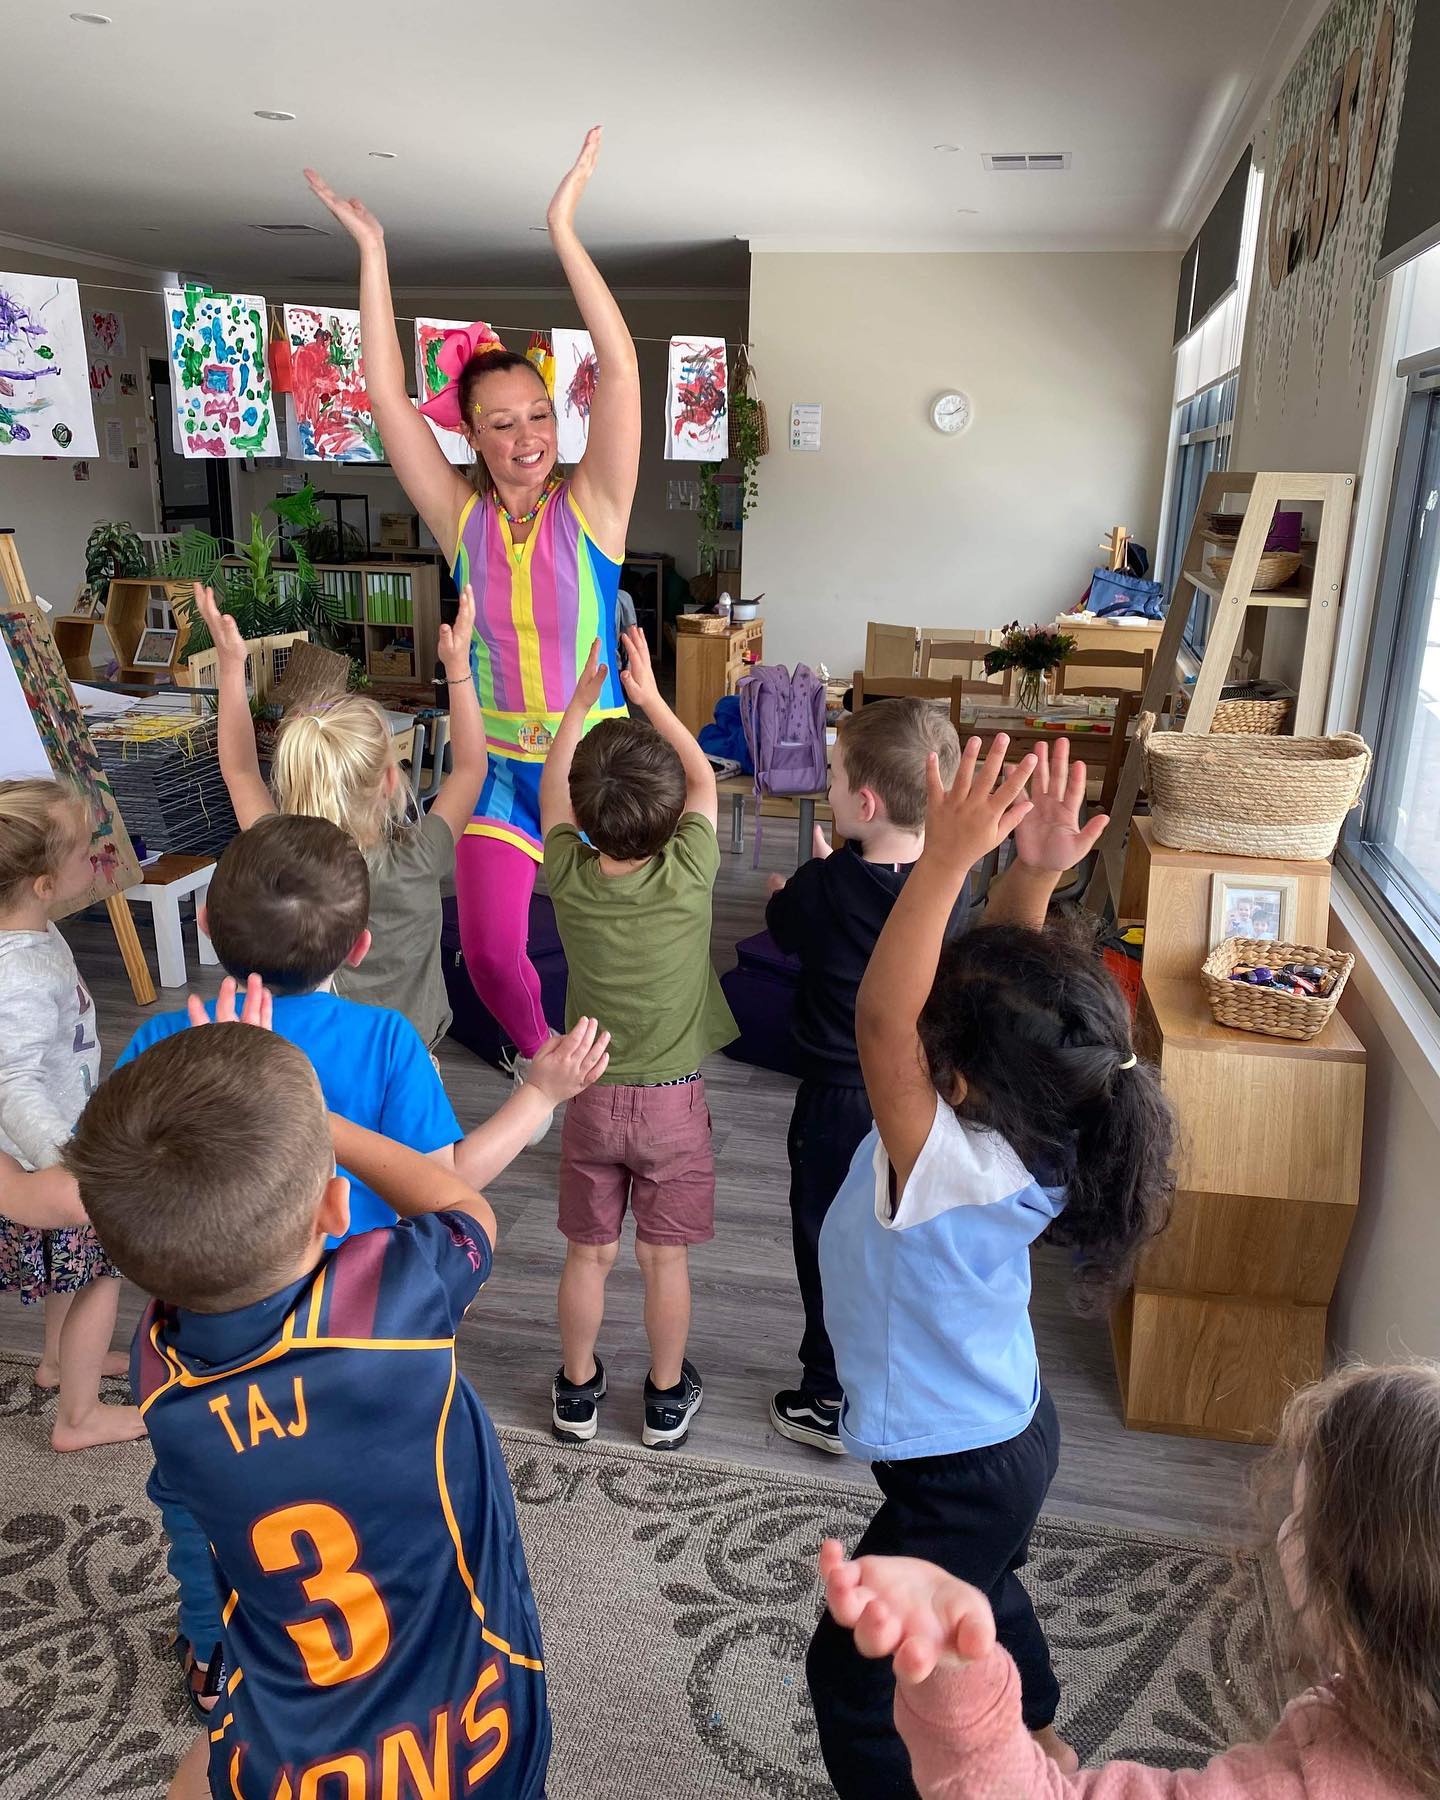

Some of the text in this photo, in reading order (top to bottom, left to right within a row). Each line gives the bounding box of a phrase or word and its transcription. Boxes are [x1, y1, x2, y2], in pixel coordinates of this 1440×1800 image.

[522, 735, 550, 745] FEET
[208, 1376, 308, 1454] TAJ
[251, 1502, 391, 1688] 3
